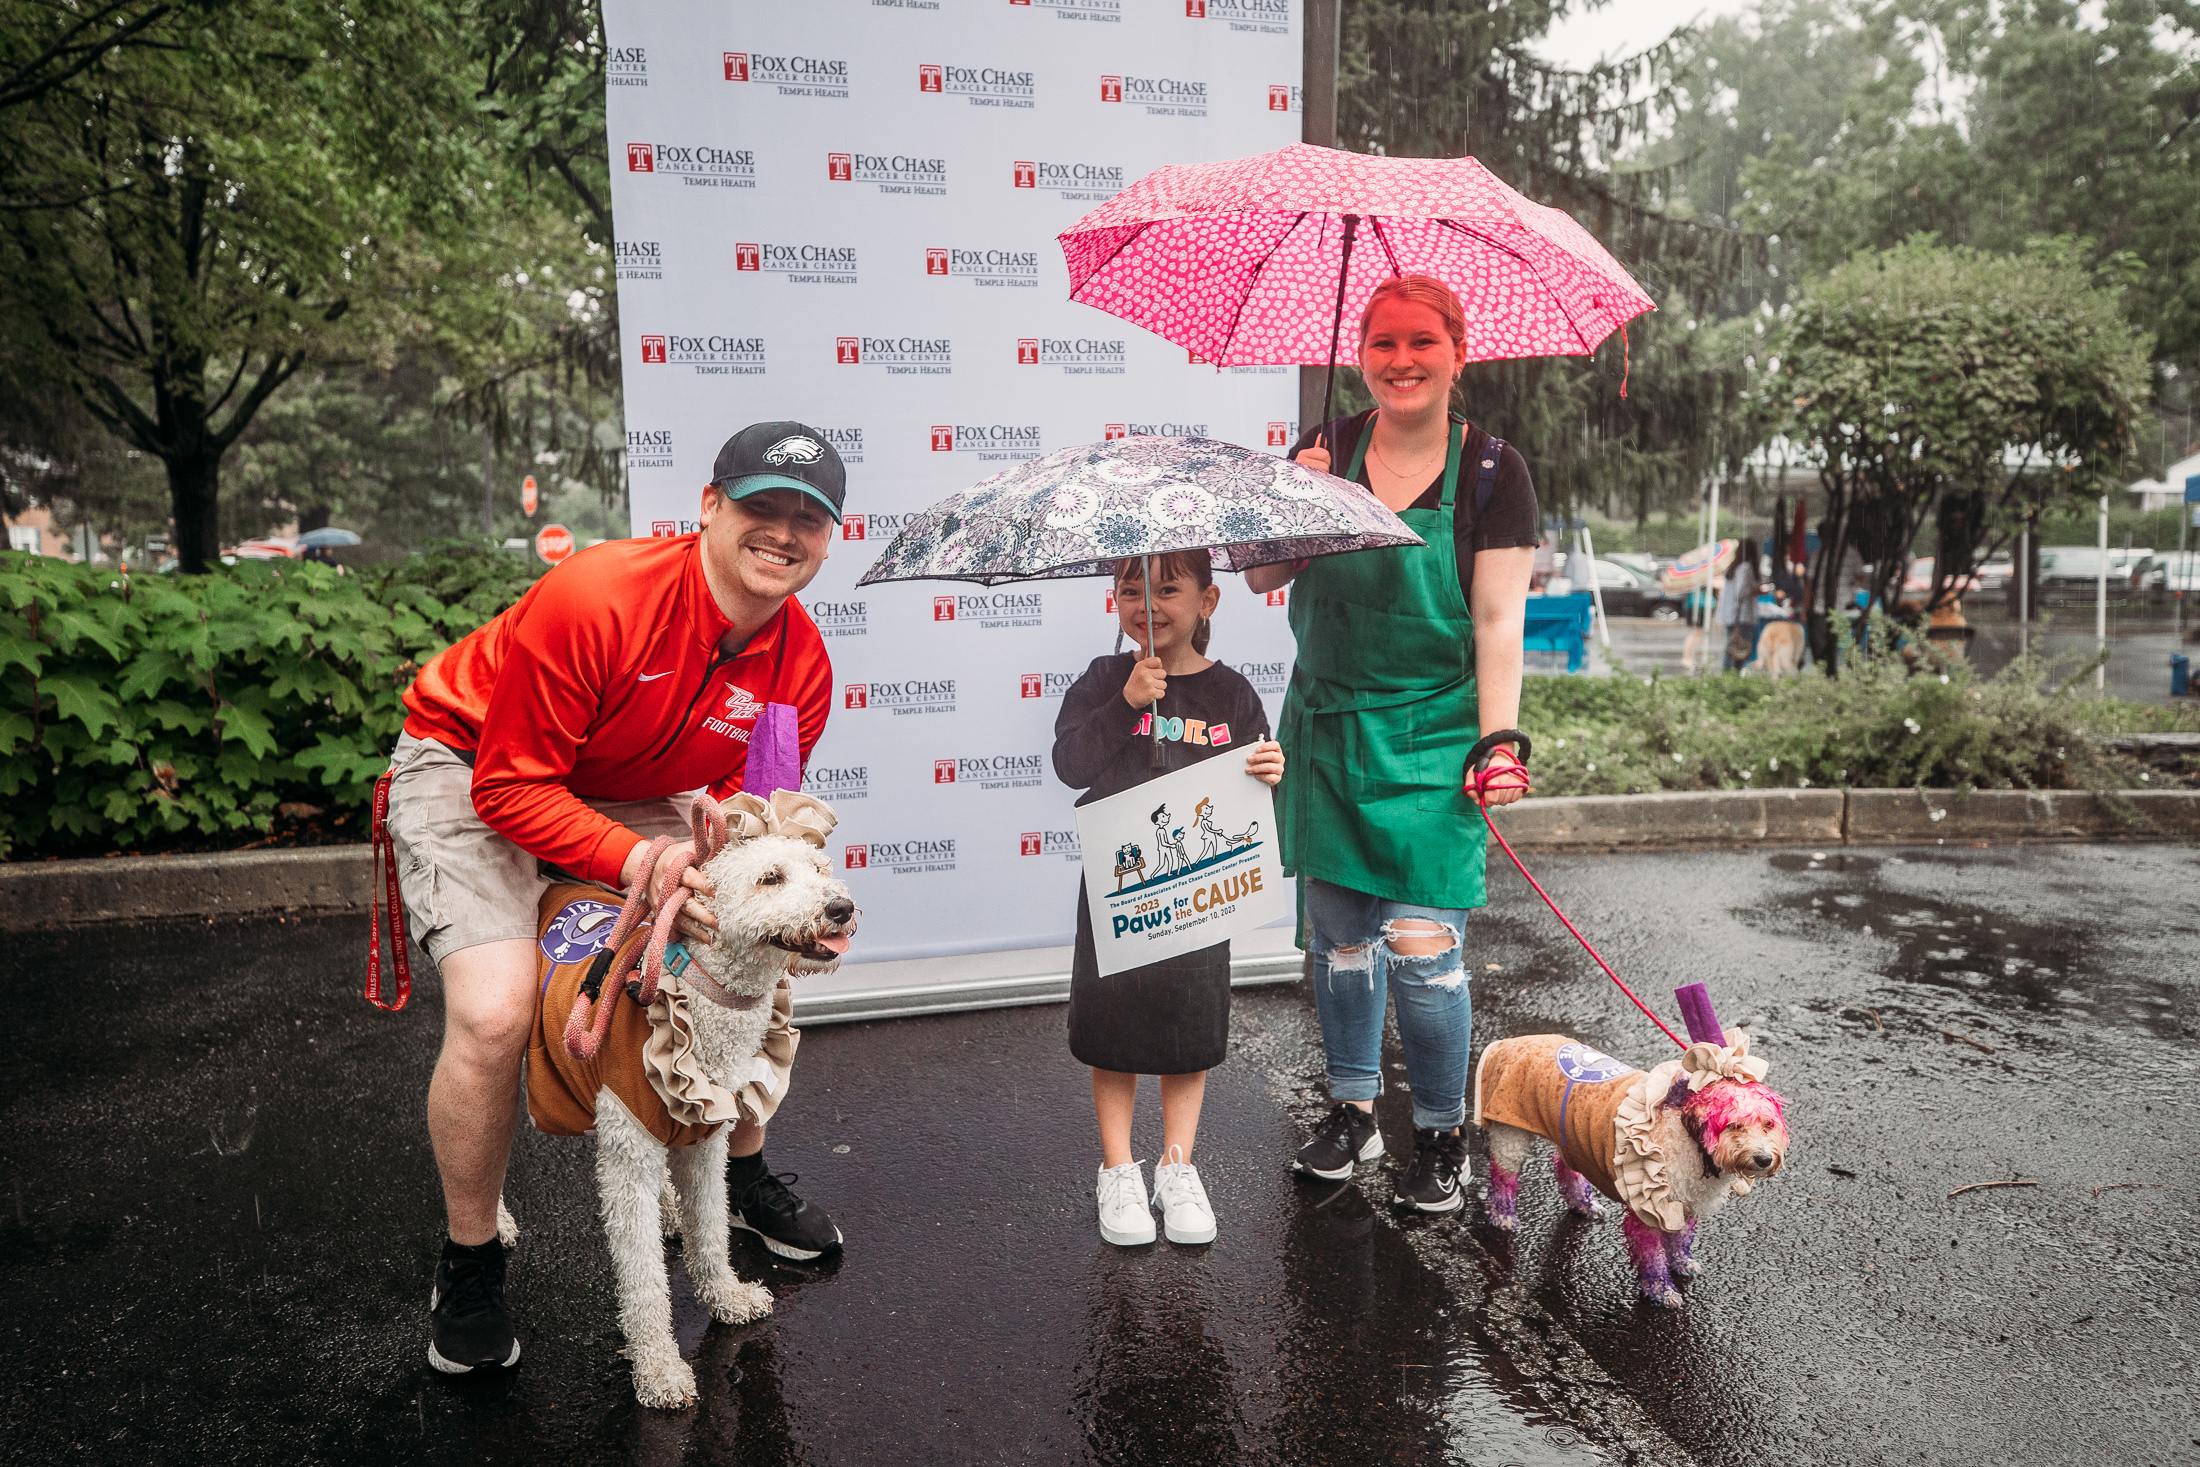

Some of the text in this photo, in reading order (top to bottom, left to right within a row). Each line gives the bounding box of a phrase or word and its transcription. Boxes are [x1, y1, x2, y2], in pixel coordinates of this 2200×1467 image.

[1242, 0, 1289, 12] CHASE
[751, 54, 848, 74] FOX CHASE
[752, 72, 848, 84] CANCER CENTER
[945, 66, 1034, 85] FOX CHASE
[778, 86, 848, 98] TEMPLE HEALTH
[1124, 77, 1207, 95] FOX CHASE
[656, 144, 755, 164] FOX CHASE
[657, 162, 755, 173] CANCER CENTER
[855, 154, 946, 172] FOX CHASE
[855, 171, 946, 181] CANCER CENTER
[1038, 162, 1123, 179] FOX CHASE
[683, 177, 755, 188] TEMPLE HEALTH
[879, 185, 946, 195] TEMPLE HEALTH
[615, 242, 661, 256] HASE
[763, 244, 856, 261] FOX CHASE
[951, 249, 1038, 265] FOX CHASE
[763, 261, 857, 270] CANCER CENTER
[626, 270, 662, 279] HEALTH
[788, 274, 857, 283] TEMPLE HEALTH
[669, 336, 765, 352] FOX CHASE
[862, 337, 951, 353] FOX CHASE
[1041, 339, 1125, 354] FOX CHASE
[695, 366, 765, 374] TEMPLE HEALTH
[886, 366, 951, 374] TEMPLE HEALTH
[814, 427, 863, 442] HASE
[955, 425, 1040, 440] FOX CHASE
[1128, 423, 1208, 437] FOX CHASE
[628, 430, 672, 445] HASE
[638, 459, 673, 467] HEALTH
[868, 514, 900, 528] FOX
[540, 536, 570, 552] STOP
[958, 593, 1042, 609] FOX CHASE
[814, 601, 867, 617] CHASE
[958, 606, 1042, 617] CANCER CENTER
[826, 615, 867, 624] CENTER
[1012, 619, 1042, 627] HEALTH
[835, 628, 867, 636] HEALTH
[1240, 662, 1285, 676] CHASE
[1044, 672, 1074, 686] FOX
[870, 680, 956, 697] FOX CHASE
[870, 692, 956, 705] CANCER CENTER
[892, 705, 956, 715] TEMPLE HEALTH
[702, 716, 750, 744] FOOTBAL
[1183, 718, 1208, 745] IT.
[958, 755, 1042, 772] FOX CHASE
[816, 766, 868, 782] CHASE
[958, 767, 1042, 779] CANCER CENTER
[827, 779, 868, 789] CENTER
[980, 779, 1042, 789] TEMPLE HEALTH
[836, 791, 868, 800] HEALTH
[376, 790, 384, 824] COLLEGE
[1044, 830, 1074, 844] FOX
[870, 839, 956, 857] FOX CHASE
[870, 851, 955, 864] CANCER CENTER
[892, 863, 955, 874] TEMPLE HEALTH
[1121, 897, 1136, 905] Board
[1144, 887, 1171, 898] Associates
[1189, 874, 1203, 883] Chase
[1204, 869, 1220, 877] Cancer
[1222, 862, 1238, 871] Center
[1239, 854, 1260, 864] Presents
[390, 881, 398, 914] COLLEGE
[1112, 867, 1263, 939] Paws for CAUSE
[1134, 899, 1160, 914] 2023
[1175, 908, 1192, 920] the
[1148, 905, 1236, 940] Sunday, September 10, 2023
[394, 936, 405, 974] CHESTNUT
